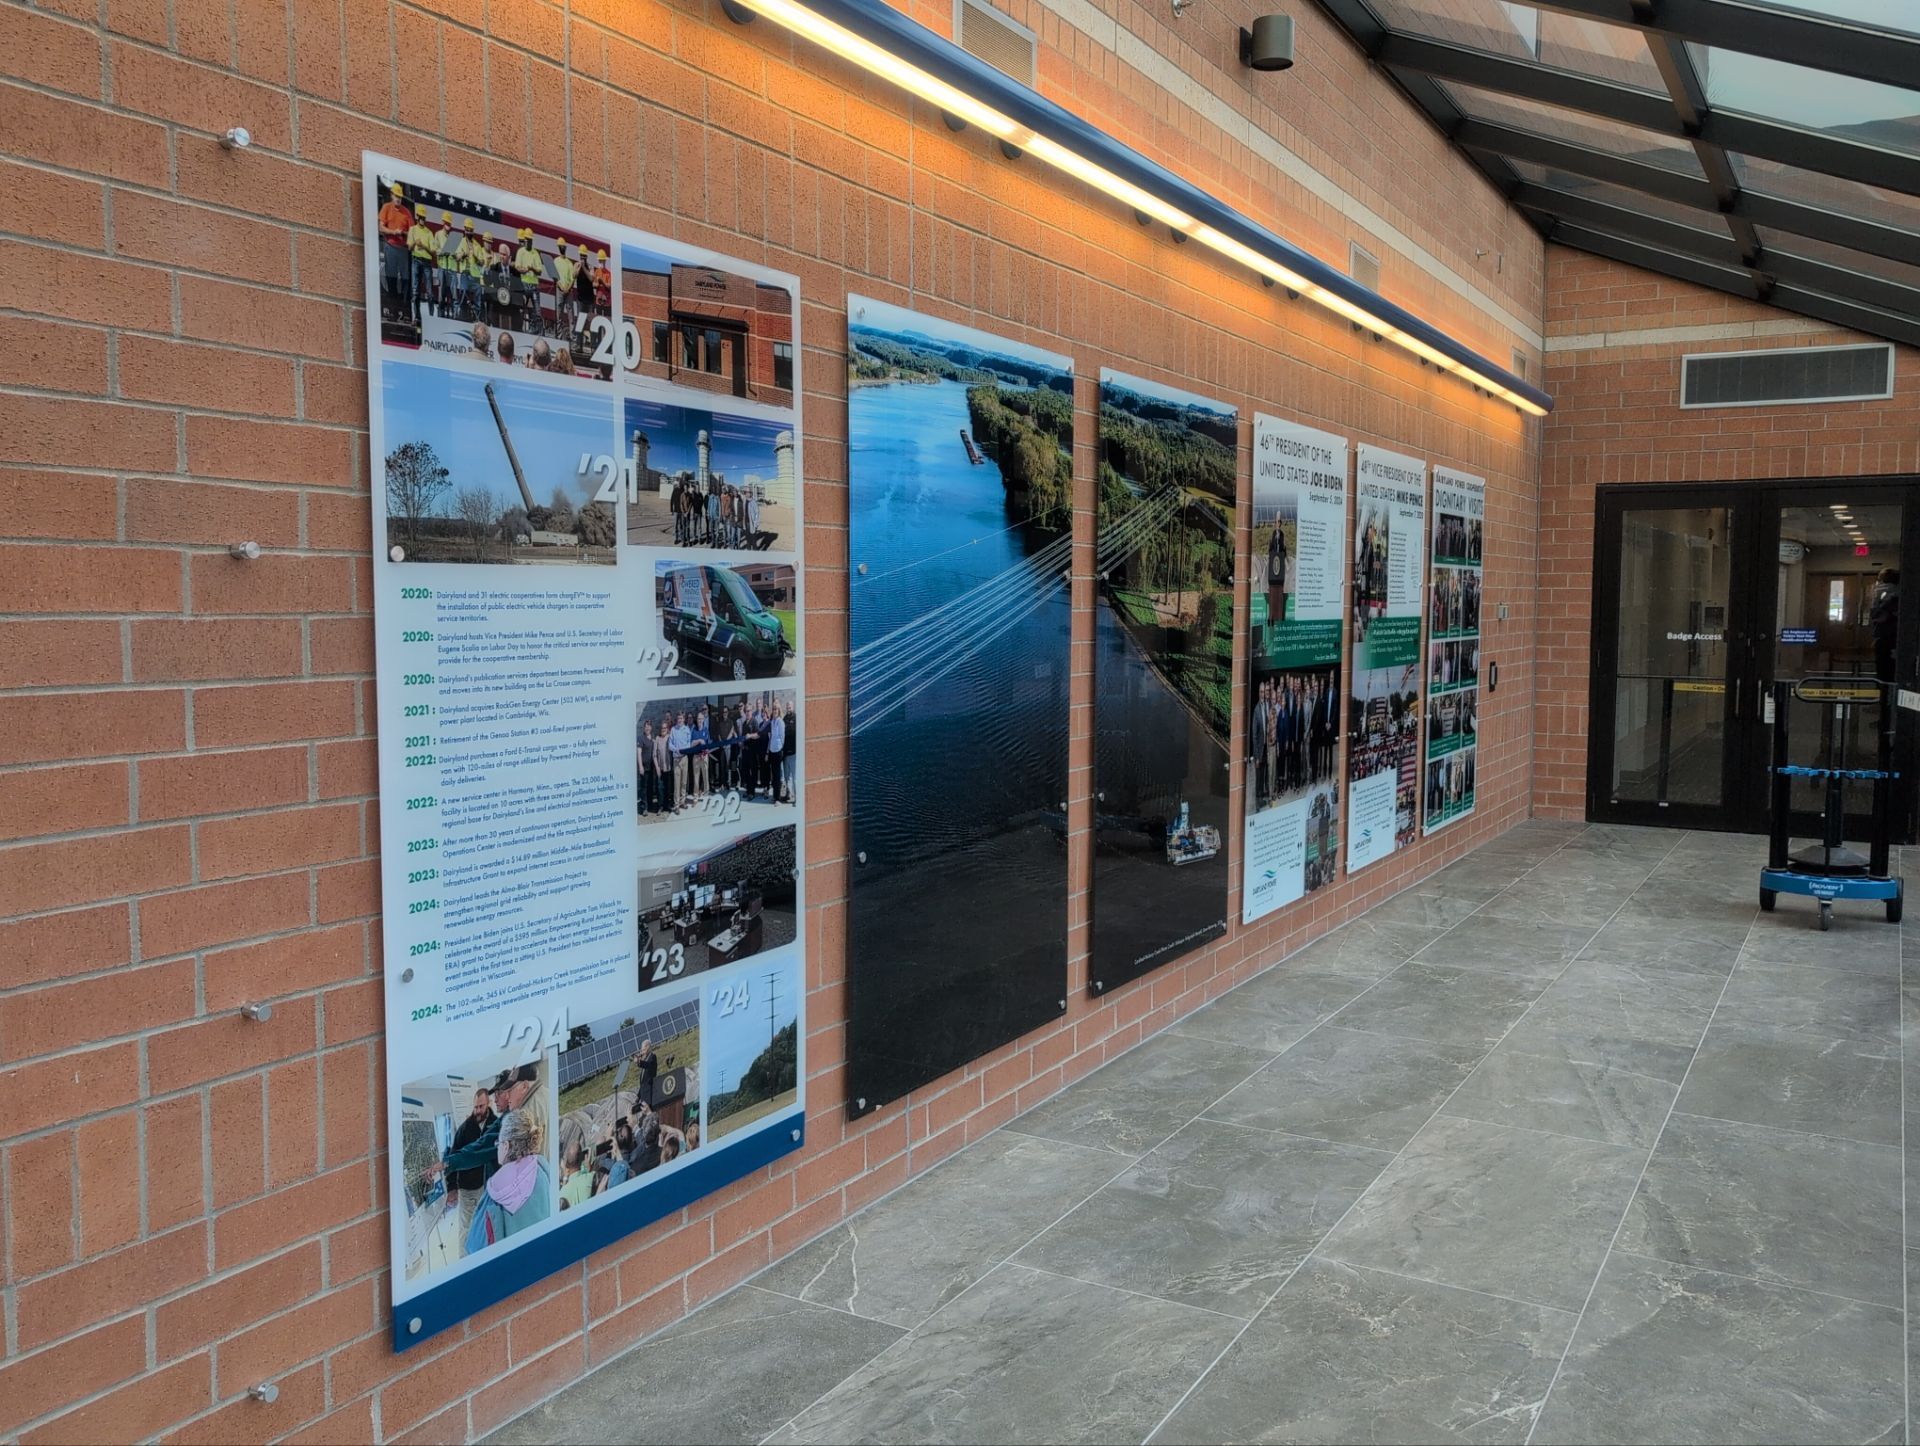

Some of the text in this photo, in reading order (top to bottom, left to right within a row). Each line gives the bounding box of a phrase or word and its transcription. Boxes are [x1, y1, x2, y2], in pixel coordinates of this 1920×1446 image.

[424, 339, 467, 354] DAIRYLAND
[576, 312, 642, 370] '20
[1276, 437, 1310, 459] PRESIDENT
[1311, 446, 1319, 461] OF
[1321, 448, 1332, 465] THE
[578, 453, 638, 504] '21
[1260, 460, 1343, 491] UNITED STATES JOE BIDEN
[1372, 463, 1382, 478] VICE
[1383, 466, 1406, 482] PRESIDENT
[1407, 471, 1413, 484] OF
[1309, 491, 1328, 504] September
[1361, 482, 1423, 507] UNITED STATES MIKE PENCE
[1436, 490, 1483, 515] DIGNITARY VISITS
[401, 588, 432, 599] 2020:
[436, 591, 467, 601] Dairyland
[489, 591, 510, 599] electric
[510, 592, 545, 601] cooperatives
[447, 601, 545, 612] installation public vehicle
[437, 614, 458, 622] service
[402, 631, 433, 642] 2020:
[437, 632, 523, 643] Dairyland Vice President
[1667, 632, 1722, 641] Badge Access
[437, 640, 552, 655] Eugene Scalia Labor Day honor the
[438, 654, 516, 666] provide the cooperative
[404, 674, 434, 685] 2020:
[473, 672, 506, 684] publication
[506, 671, 528, 680] services
[439, 686, 451, 695] and
[504, 681, 527, 692] building
[439, 704, 470, 715] Dairyland
[521, 699, 541, 708] Energy
[542, 698, 559, 706] Center
[439, 718, 459, 728] power
[460, 715, 475, 726] plant
[476, 712, 498, 723] located
[440, 729, 530, 744] Retirement the Genoa Station
[405, 754, 436, 767] 2022:
[438, 752, 469, 764] Dairyland
[453, 764, 465, 774] with
[441, 777, 456, 787] daily
[407, 796, 437, 810] 2022:
[447, 797, 460, 805] new
[461, 793, 482, 803] service
[441, 806, 462, 816] facility
[468, 802, 490, 812] located
[508, 799, 524, 807] acres
[442, 815, 482, 829] regional base
[408, 838, 438, 852] 2023:
[442, 829, 513, 847] After 30 years
[442, 843, 496, 859] Operations Center
[442, 857, 505, 877] Dairyland awarded
[408, 869, 439, 883] 2023:
[443, 870, 499, 888] Infrastructure Grant
[443, 890, 490, 907] Dairyland leads
[475, 896, 512, 912] regional grid
[409, 899, 440, 914] 2024:
[444, 916, 475, 930] renewable
[475, 913, 496, 922] energy
[444, 936, 471, 949] President
[472, 934, 482, 942] Joe
[483, 929, 500, 939] Biden
[410, 940, 440, 956] 2024:
[444, 938, 502, 959] celebrate award
[461, 956, 477, 968] grant
[484, 946, 513, 962] Dairyland
[641, 943, 686, 982] '23
[445, 961, 501, 982] event first
[445, 978, 480, 993] cooperative
[445, 1000, 457, 1012] The
[507, 976, 553, 994] Cardinal-Hickory
[501, 992, 529, 1006] renewable
[530, 988, 549, 997] energy
[411, 1004, 442, 1021] 2024:
